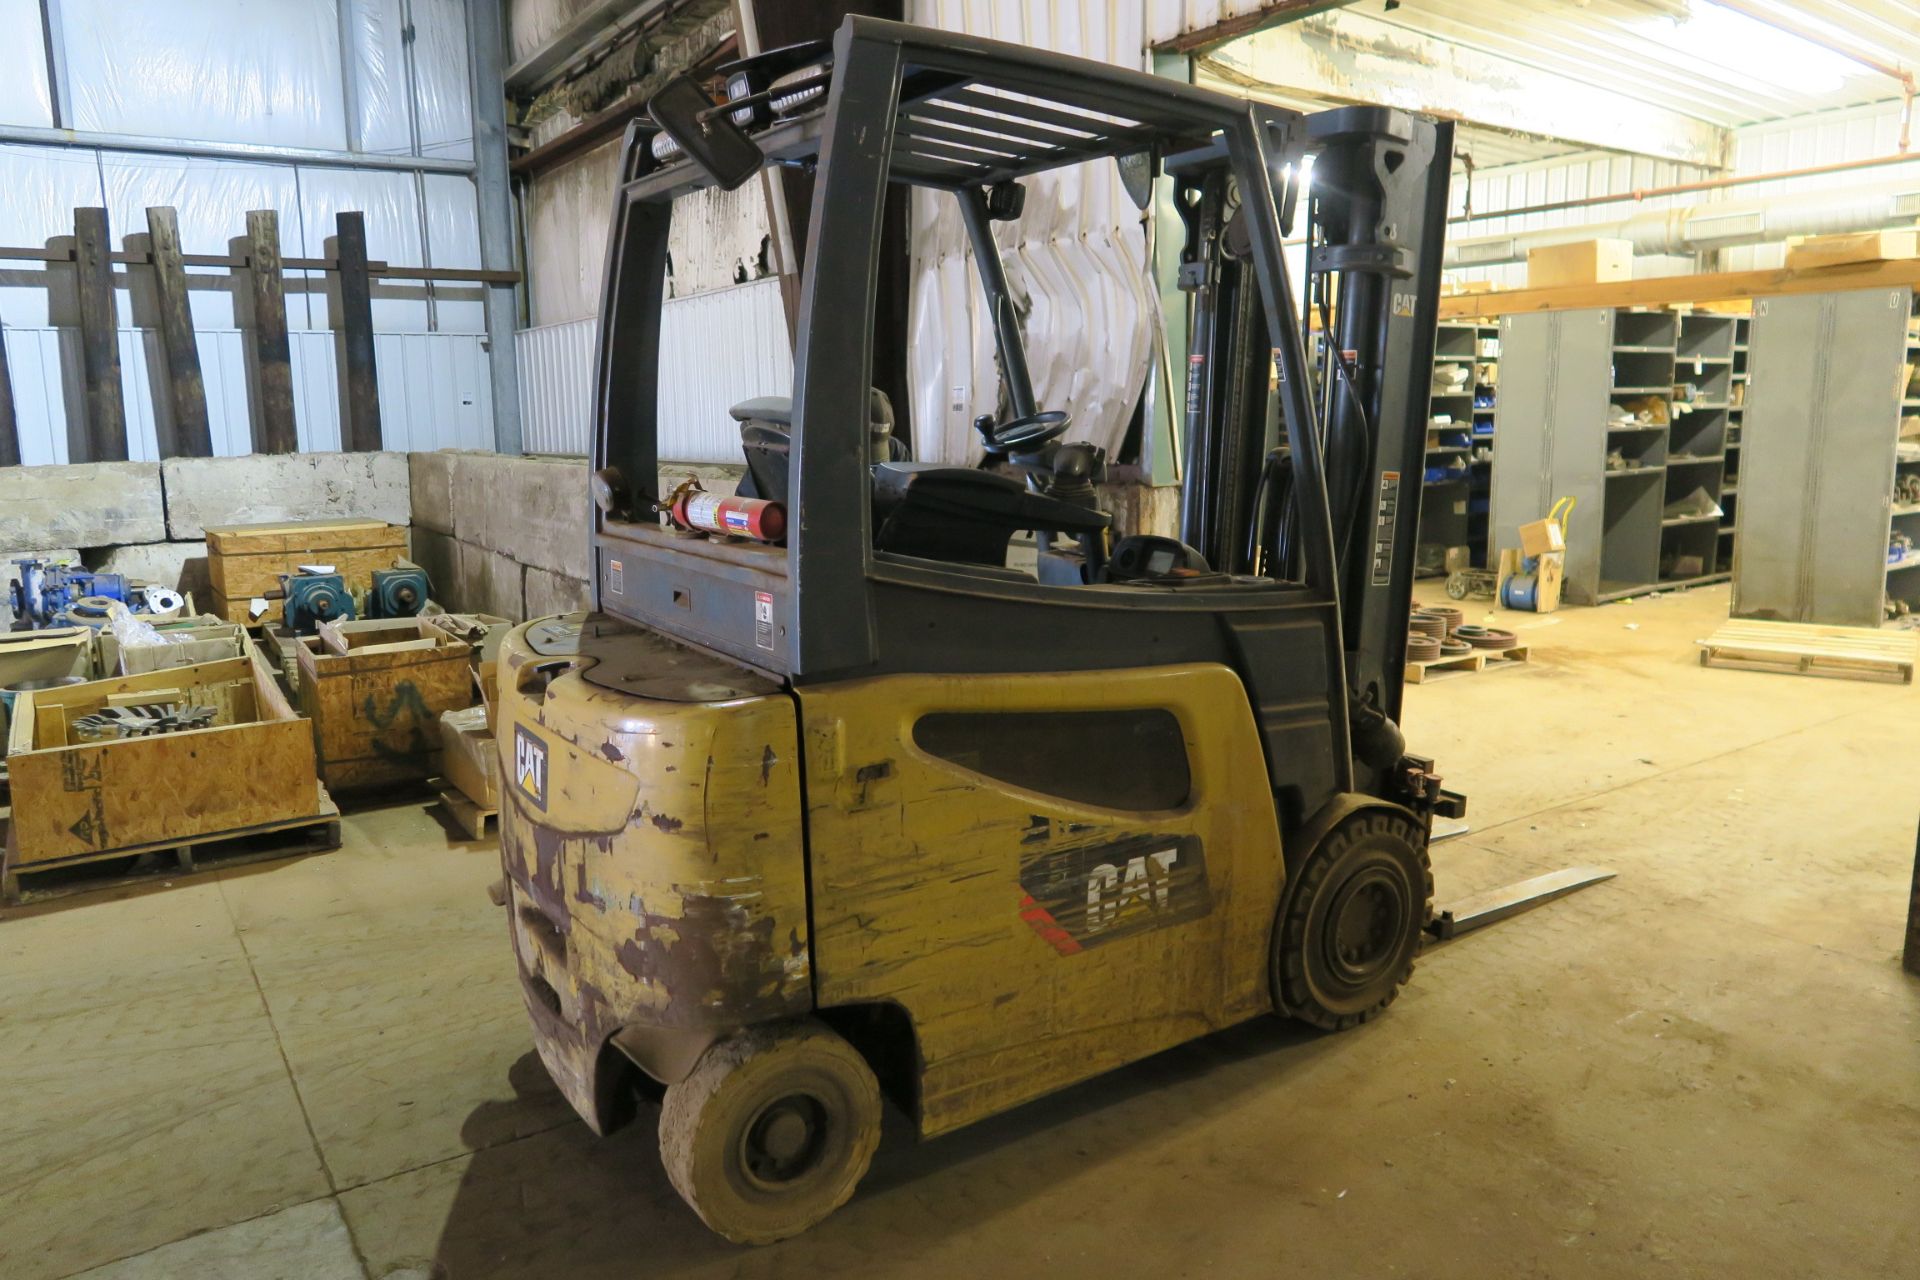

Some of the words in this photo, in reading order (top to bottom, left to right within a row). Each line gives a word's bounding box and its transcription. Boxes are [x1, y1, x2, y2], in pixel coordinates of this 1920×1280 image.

[1393, 293, 1417, 317] CAT
[517, 733, 544, 801] CAT
[1087, 848, 1177, 932] CAT
